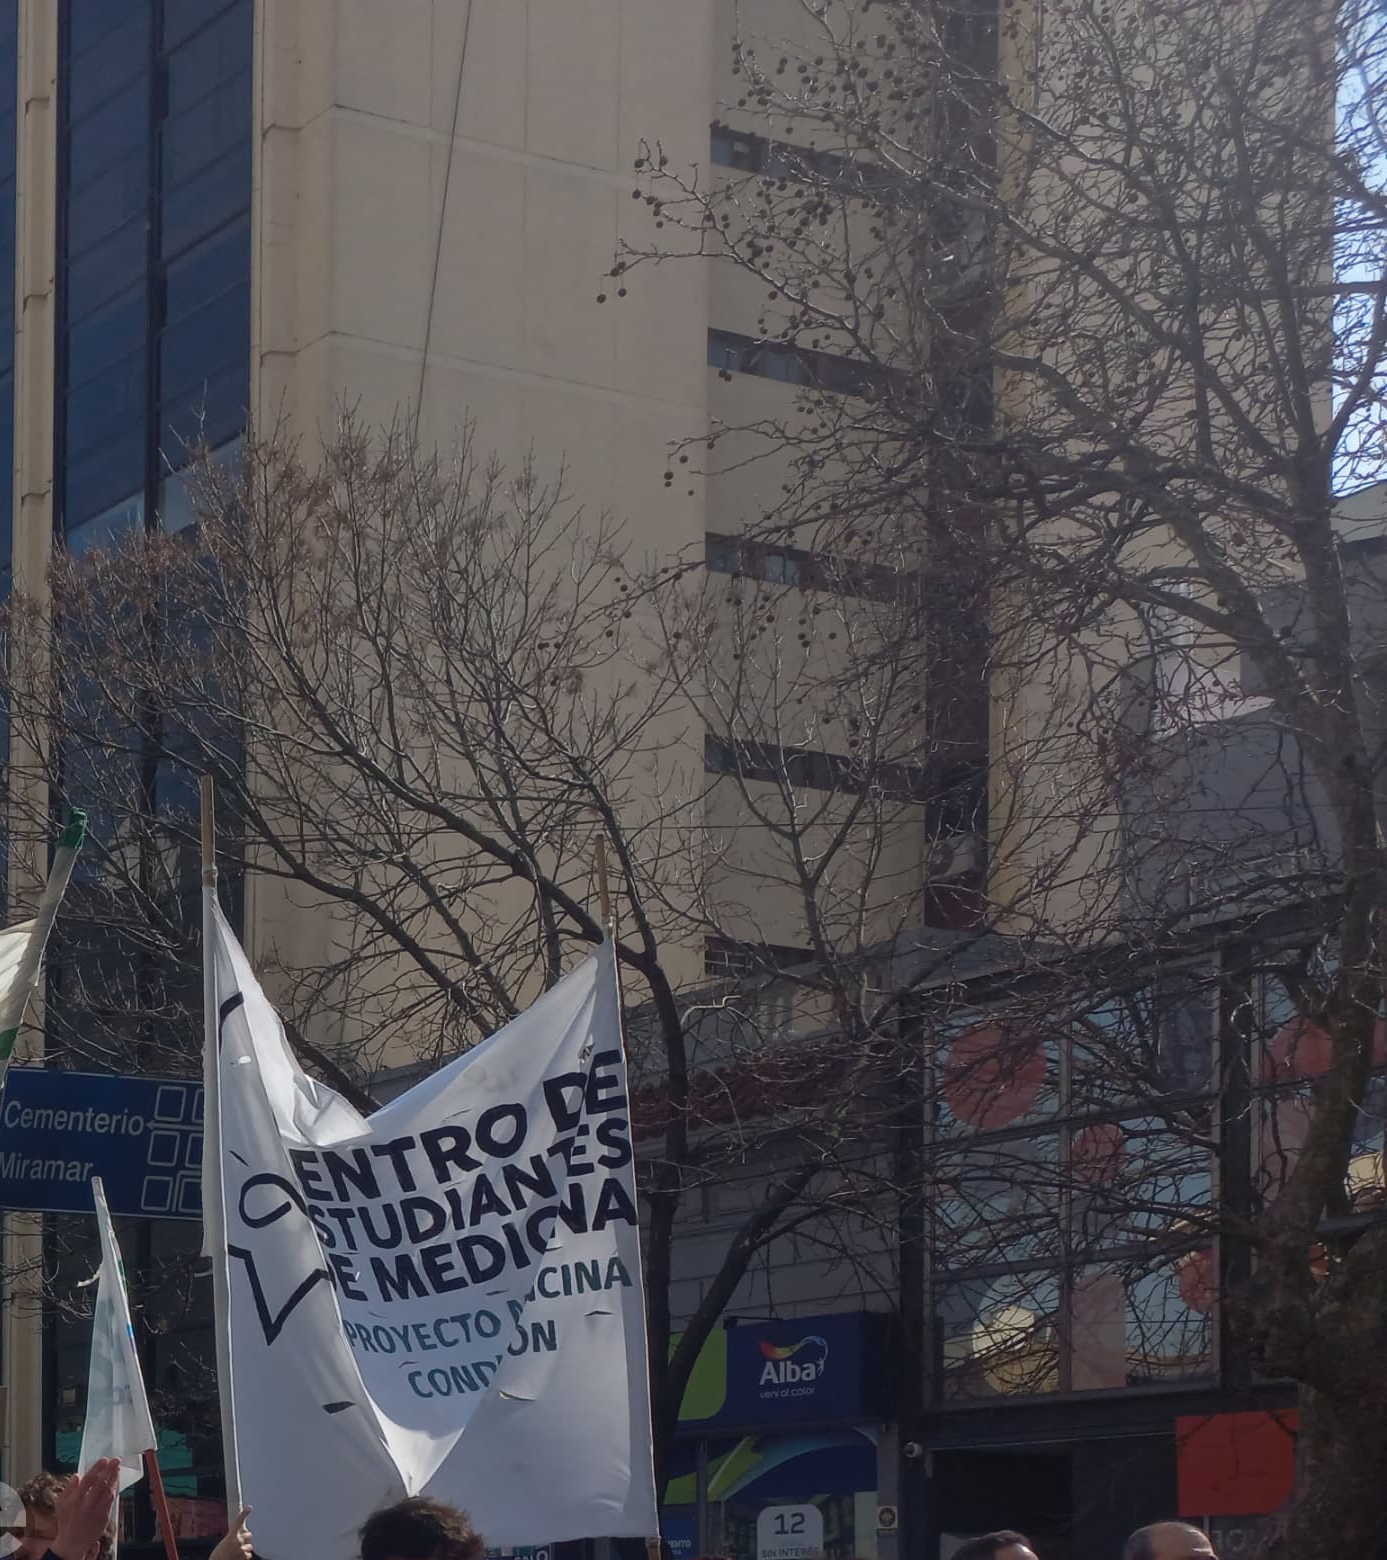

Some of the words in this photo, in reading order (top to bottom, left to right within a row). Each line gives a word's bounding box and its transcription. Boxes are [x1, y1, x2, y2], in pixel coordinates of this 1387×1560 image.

[3, 1100, 145, 1136] Cementerio
[289, 1103, 528, 1201] ENTRO
[543, 1049, 627, 1133] DE
[306, 1117, 633, 1250] STUDIANTES
[759, 1360, 816, 1385] Alba
[774, 1513, 806, 1535] 12
